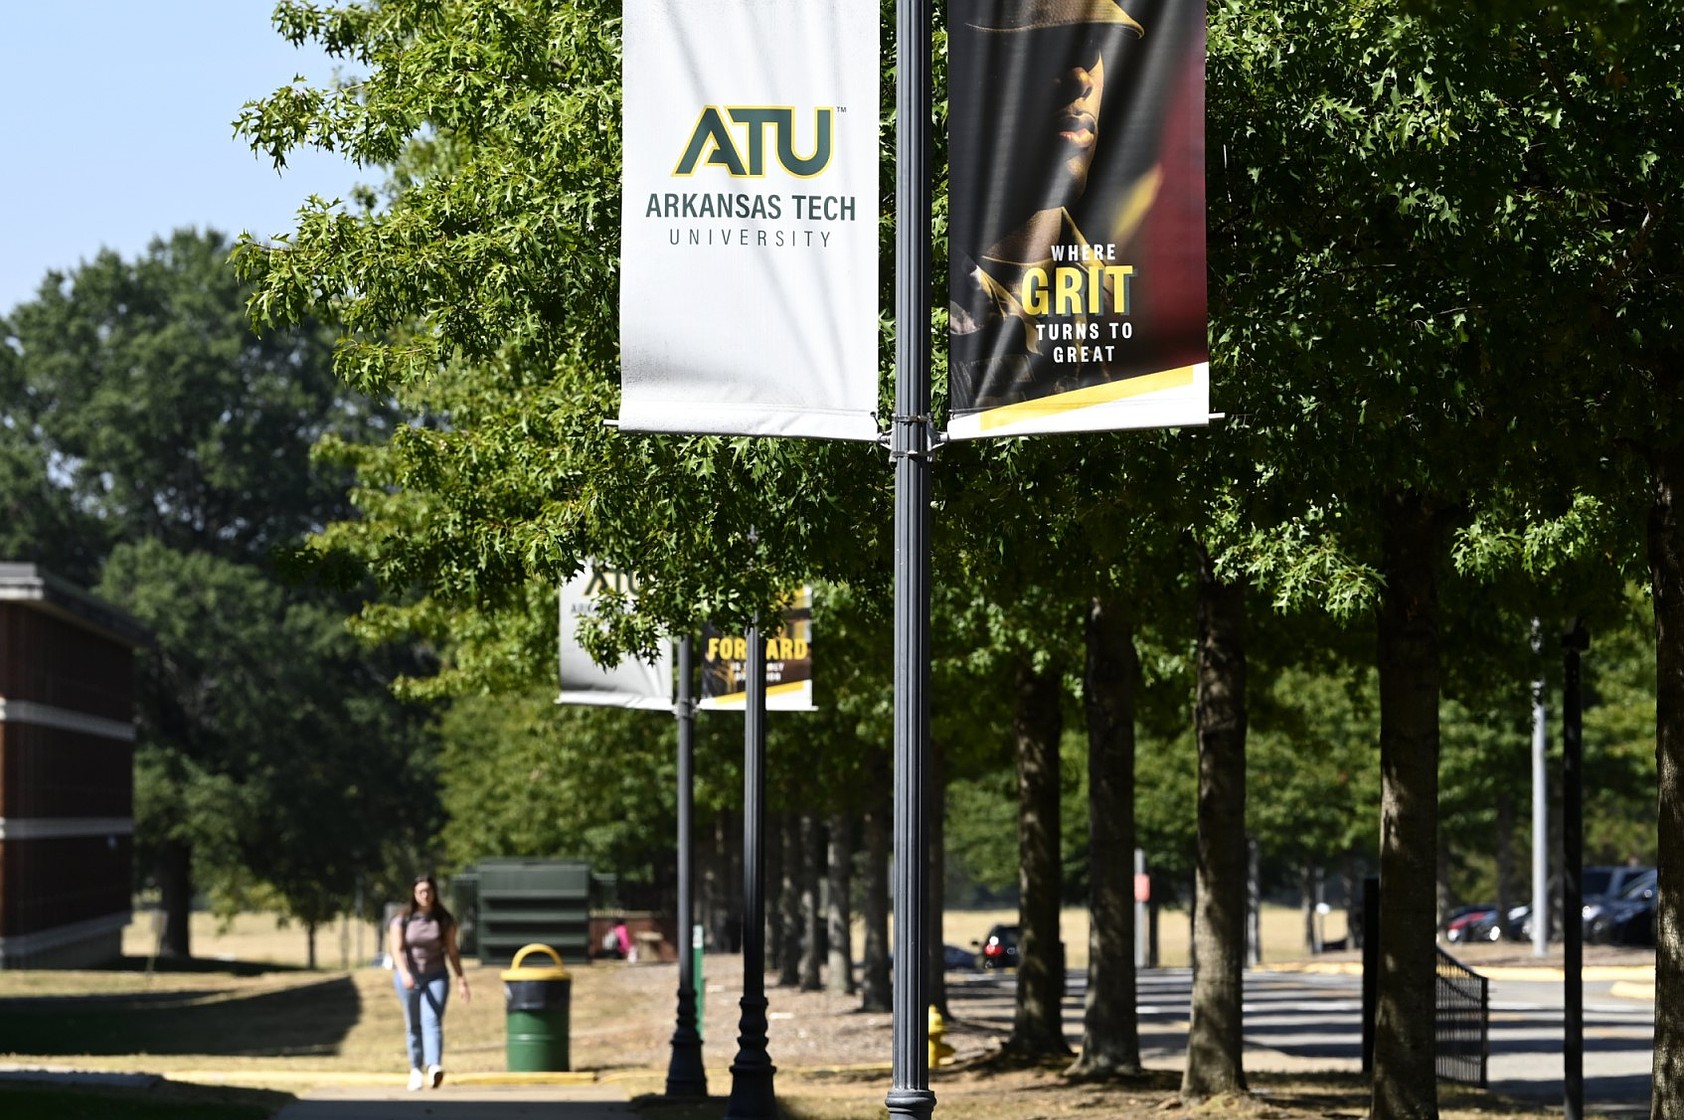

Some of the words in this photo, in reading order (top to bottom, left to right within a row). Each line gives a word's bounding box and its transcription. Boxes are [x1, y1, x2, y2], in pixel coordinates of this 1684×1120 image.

[671, 105, 834, 180] ATU
[645, 193, 782, 220] ARKANSAS
[791, 194, 856, 221] TECH
[669, 228, 831, 248] UNIVERSITY
[1050, 243, 1117, 262] WHERE
[1021, 264, 1135, 317] GRIT
[1035, 322, 1100, 341] TURNS
[1108, 321, 1134, 340] TO
[1052, 345, 1116, 364] GREAT
[707, 637, 809, 661] FORARD
